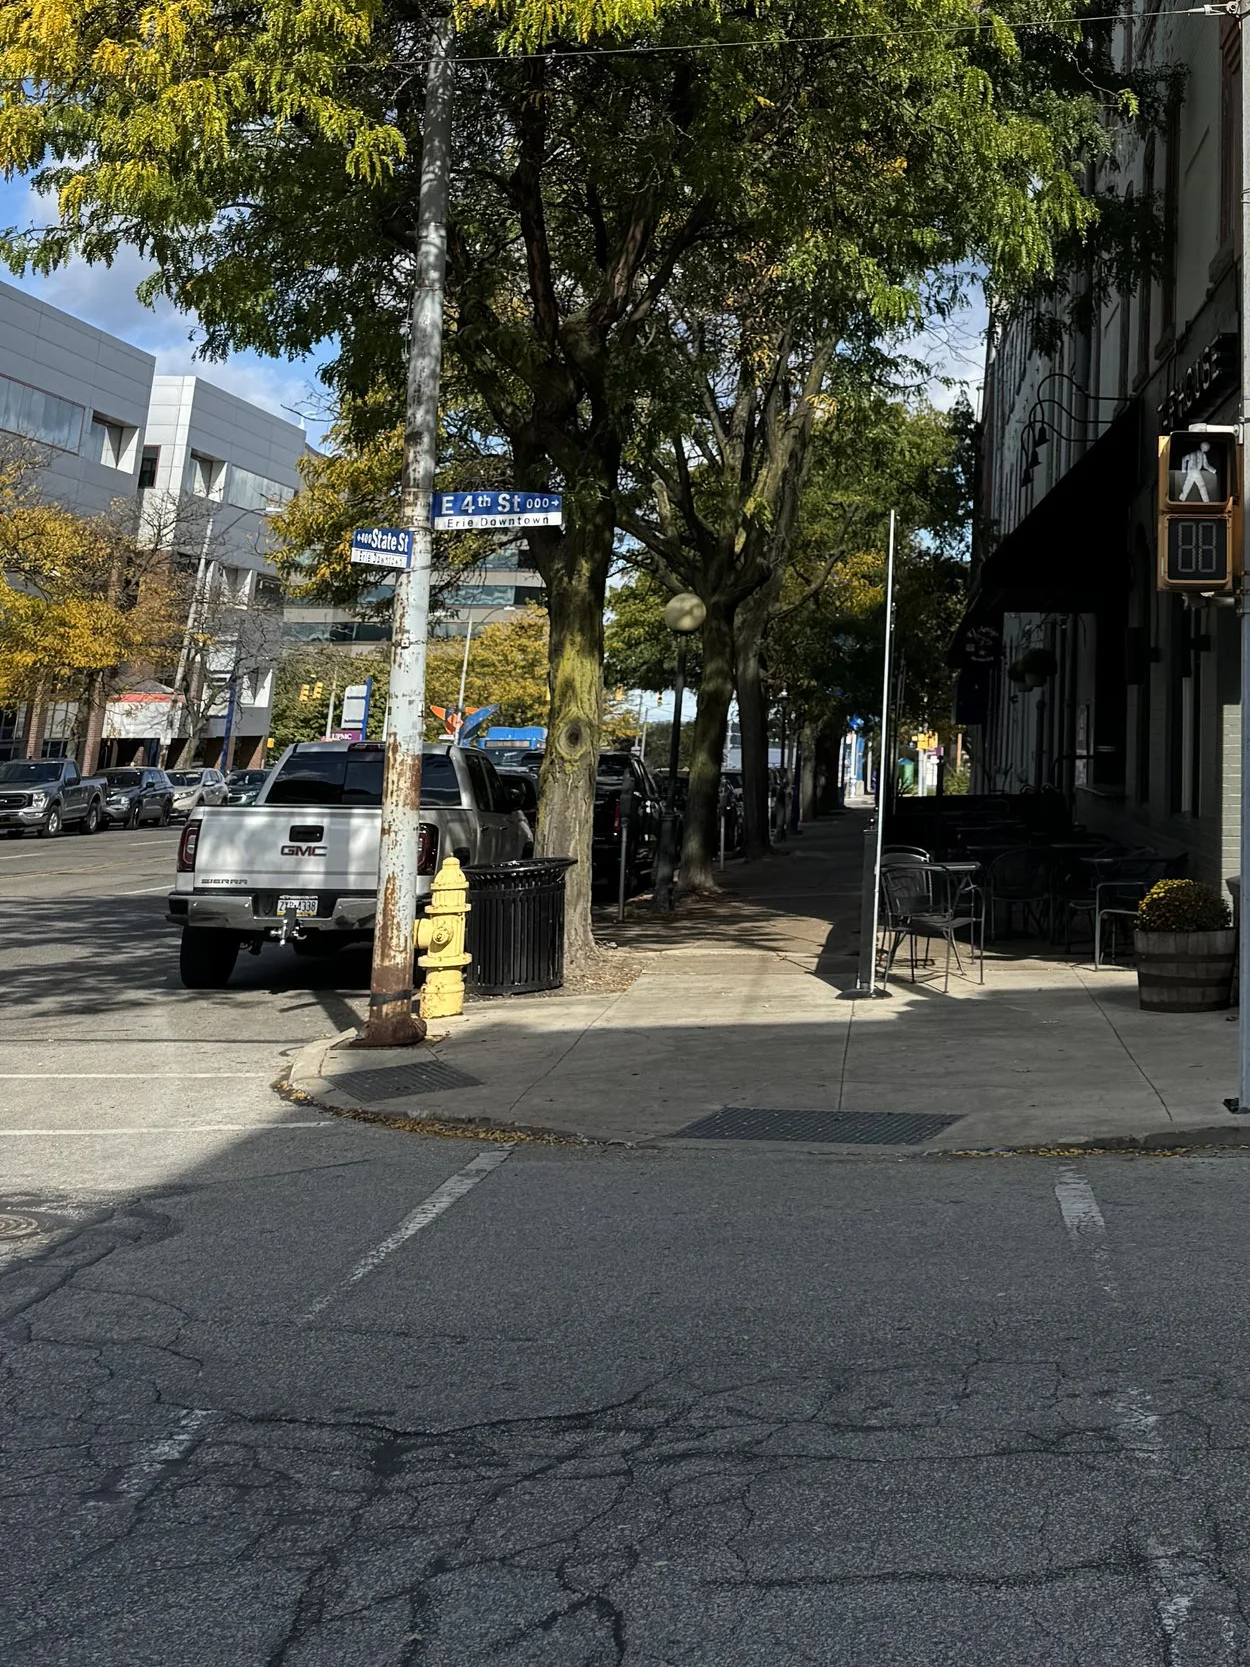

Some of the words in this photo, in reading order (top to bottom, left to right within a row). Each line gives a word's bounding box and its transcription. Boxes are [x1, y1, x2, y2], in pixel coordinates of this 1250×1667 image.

[442, 496, 454, 514] E
[461, 495, 491, 513] 4th
[498, 493, 521, 512] St
[526, 498, 549, 509] 000
[447, 518, 473, 528] Erie
[480, 516, 549, 527] Downtown
[371, 528, 397, 550] State
[398, 532, 409, 552] St
[280, 845, 328, 857] GMC
